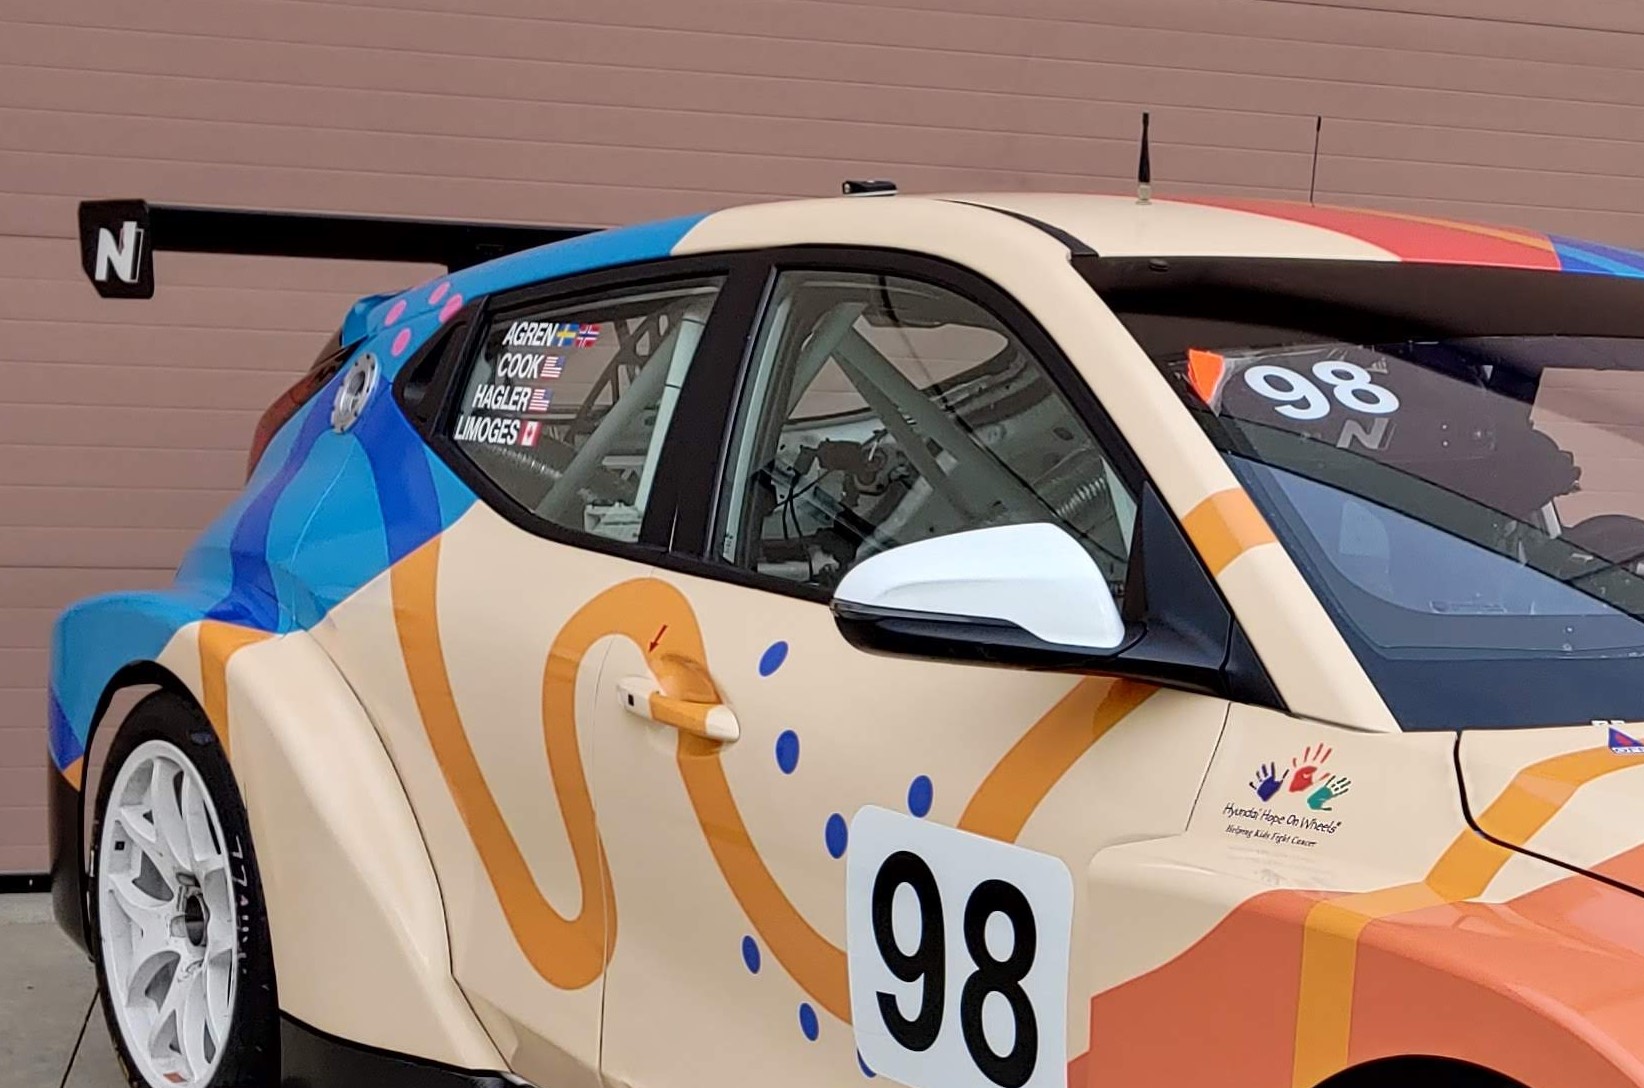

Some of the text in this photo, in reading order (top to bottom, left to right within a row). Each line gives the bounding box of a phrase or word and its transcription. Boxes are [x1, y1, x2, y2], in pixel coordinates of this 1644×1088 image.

[502, 321, 559, 347] AGREN
[498, 352, 545, 379] COOK
[472, 384, 532, 412] HAGLER
[1244, 360, 1400, 420] 98
[454, 415, 520, 445] LIMOGES
[1223, 802, 1336, 834] Hyundai Hope On Wheels
[1226, 825, 1318, 847] Helping Kids Fight Cancer
